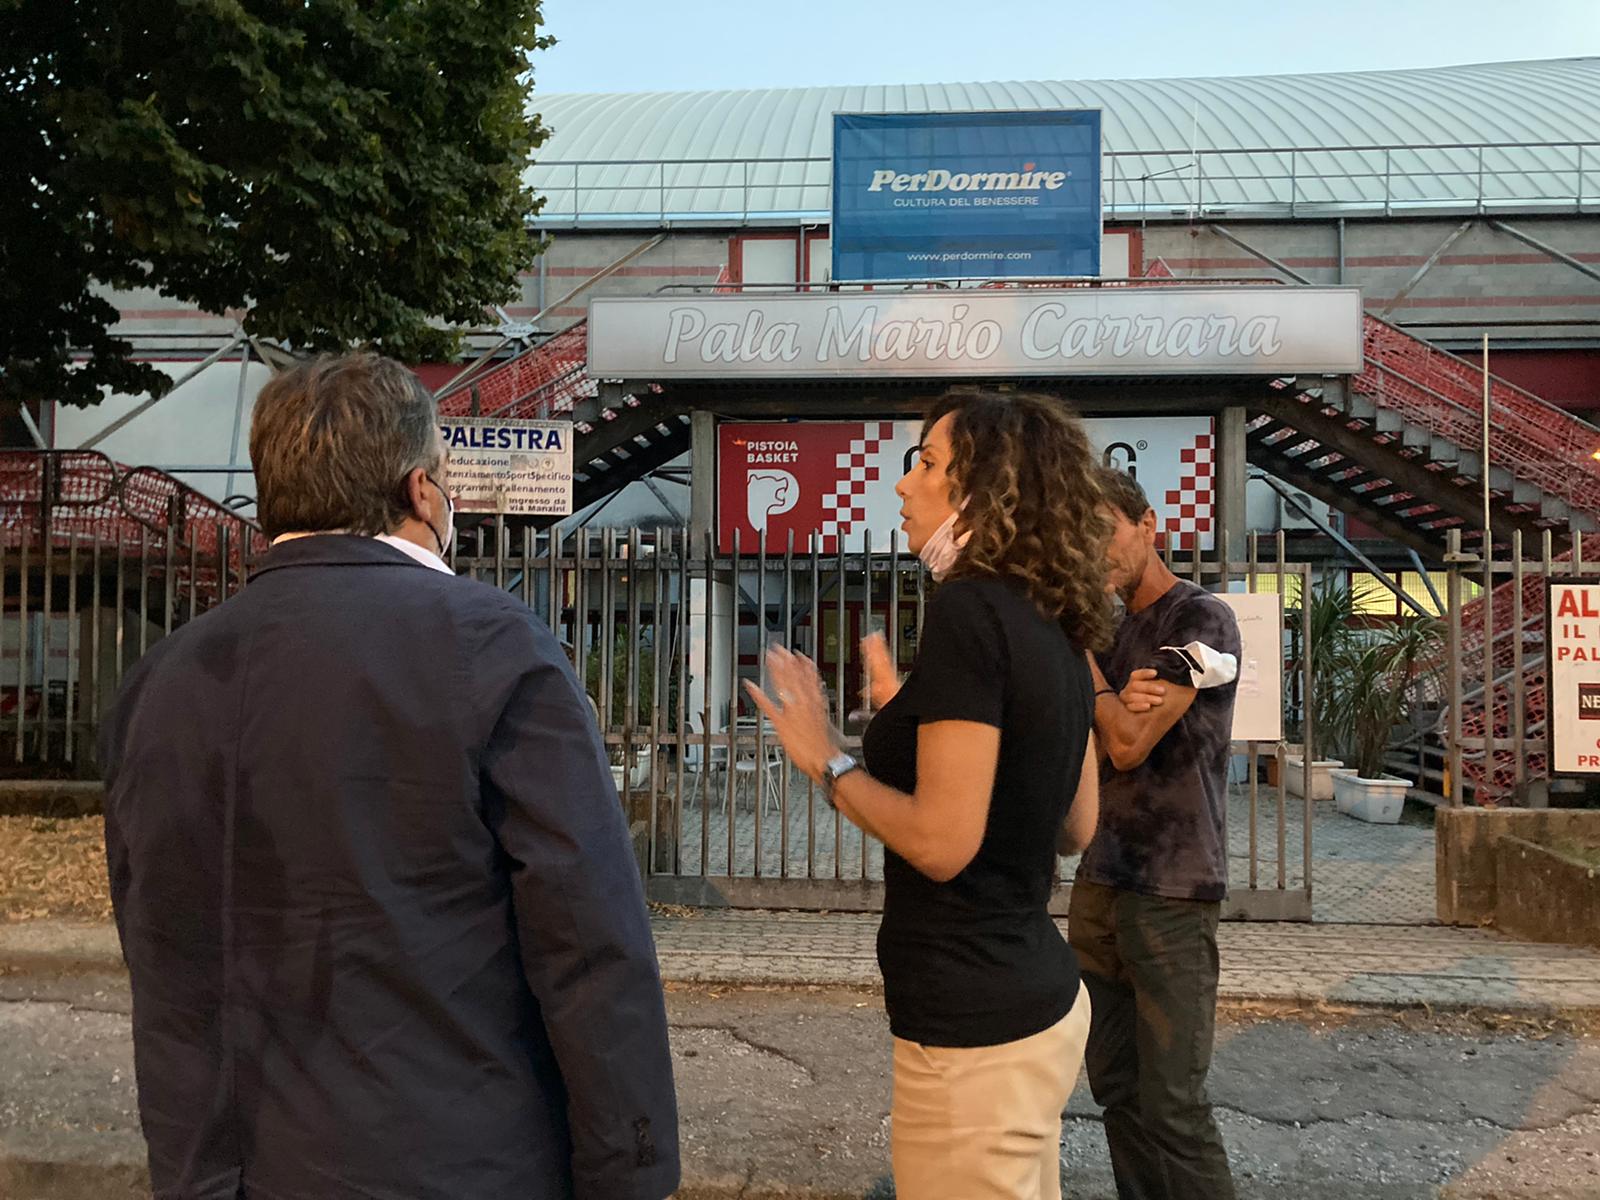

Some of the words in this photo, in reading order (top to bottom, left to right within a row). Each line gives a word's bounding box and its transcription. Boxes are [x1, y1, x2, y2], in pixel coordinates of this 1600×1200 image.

[867, 163, 1066, 191] PerDormire
[894, 198, 946, 207] CULTURA
[950, 197, 971, 206] DEL
[974, 196, 1039, 206] BENESSERE
[907, 251, 1032, 262] www.perdormire.com
[663, 307, 801, 364] Pala
[815, 303, 1001, 362] Mario
[1020, 302, 1282, 360] Carrara
[747, 441, 799, 451] PISTOIA
[747, 453, 799, 463] BASKET
[1563, 624, 1586, 638] IL
